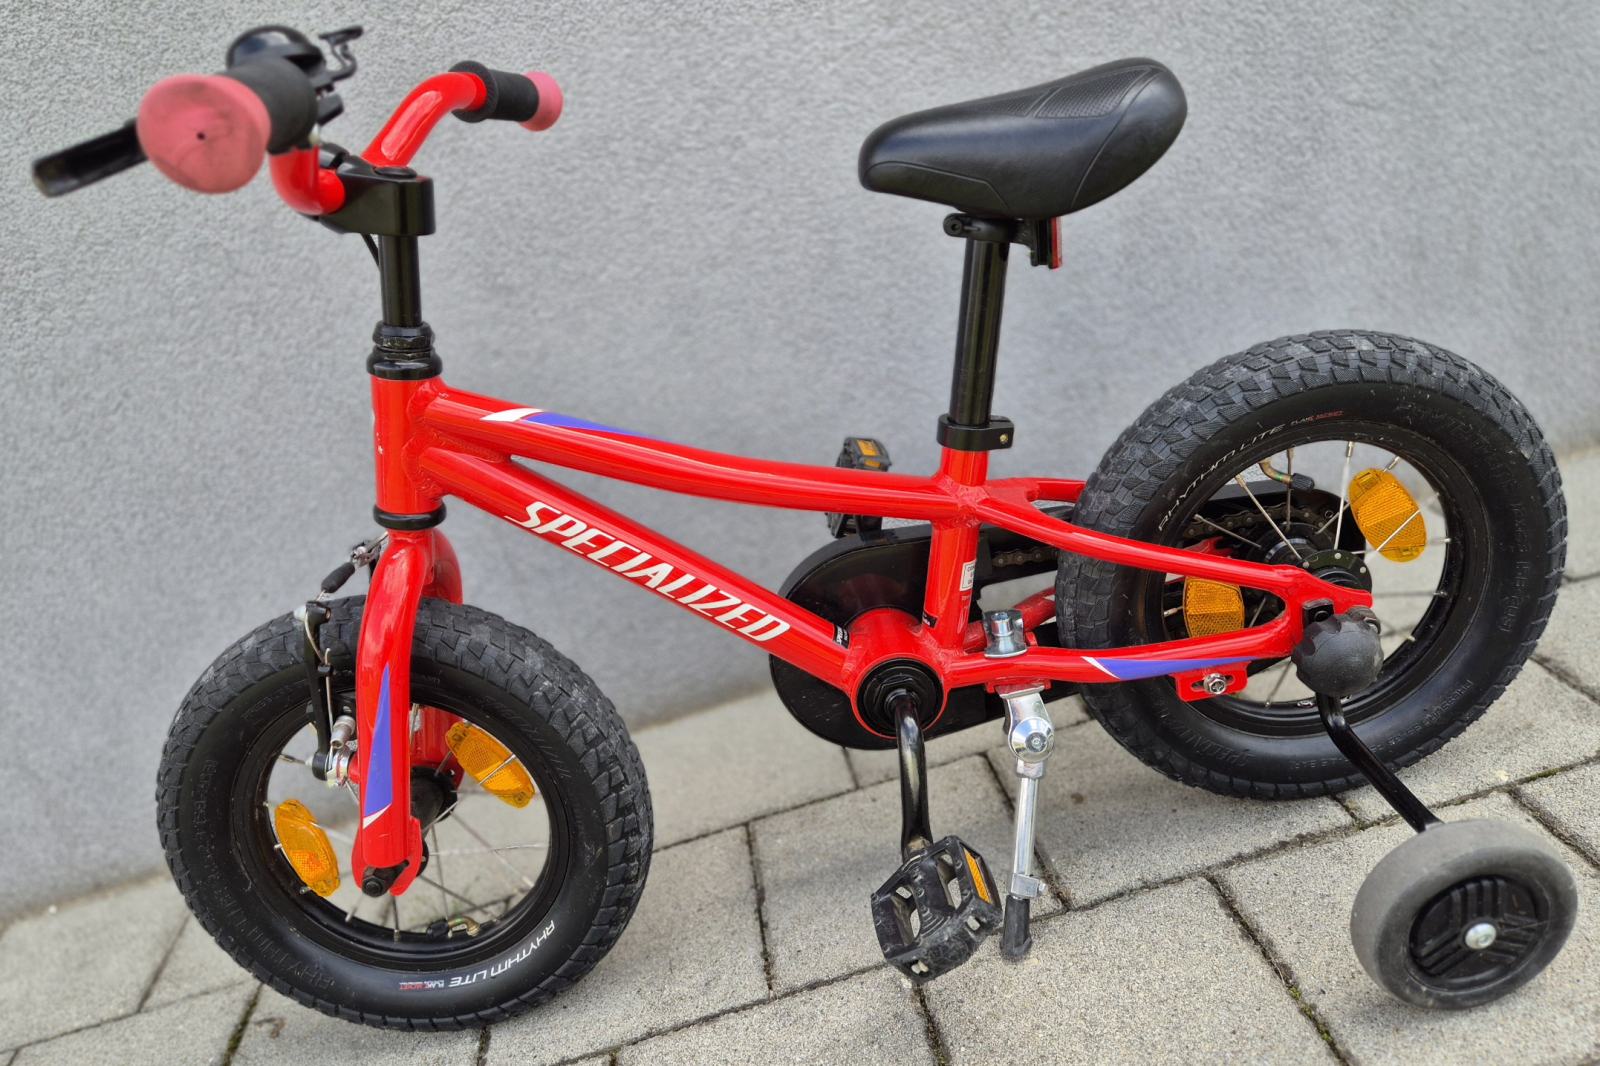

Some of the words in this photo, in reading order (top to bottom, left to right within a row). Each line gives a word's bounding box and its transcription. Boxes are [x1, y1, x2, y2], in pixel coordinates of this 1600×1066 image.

[503, 501, 791, 642] SPECIALIZED
[490, 919, 556, 977] RHYTHM
[448, 973, 487, 988] LITE
